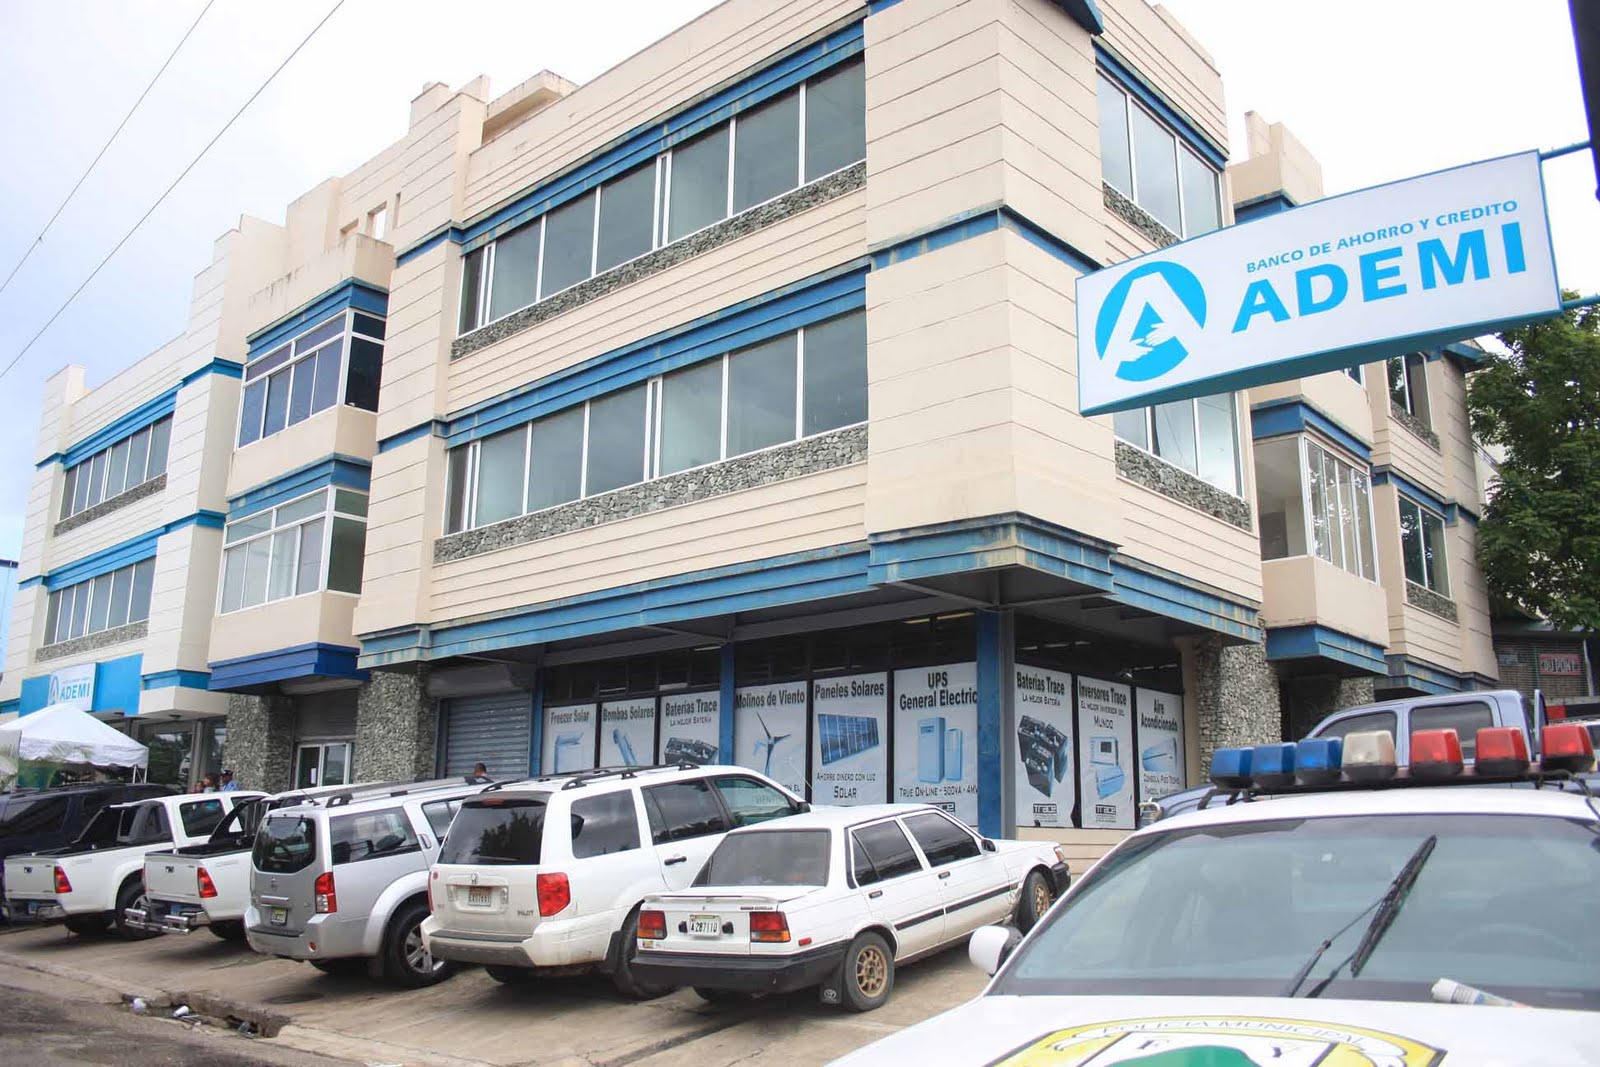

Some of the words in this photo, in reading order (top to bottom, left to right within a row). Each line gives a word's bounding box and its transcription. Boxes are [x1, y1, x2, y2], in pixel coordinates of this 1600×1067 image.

[1246, 249, 1304, 274] BANCO
[1309, 241, 1331, 258] DE
[1337, 222, 1414, 251] AHORRO
[1418, 218, 1430, 232] Y
[1435, 199, 1518, 228] CREDITO
[1231, 221, 1527, 334] ADEMI
[815, 683, 849, 700] Paneles
[851, 680, 885, 697] Solares
[928, 672, 948, 690] UPS
[1046, 676, 1065, 695] Trace
[60, 682, 91, 701] ADEMI
[735, 692, 764, 709] Molinos
[766, 691, 777, 706] de
[778, 688, 805, 705] Viento
[900, 691, 937, 710] General
[940, 687, 978, 707] Electric
[1078, 681, 1110, 702] Inversores
[1110, 687, 1127, 705] Trace
[603, 705, 629, 721] Bombas
[630, 705, 655, 720] Solares
[696, 698, 718, 713] Trace
[550, 711, 572, 725] Freezer
[574, 708, 590, 723] Solar
[867, 772, 876, 781] LUZ
[833, 785, 857, 798] SOLAR
[1217, 1020, 1367, 1044] MUNICIPAL
